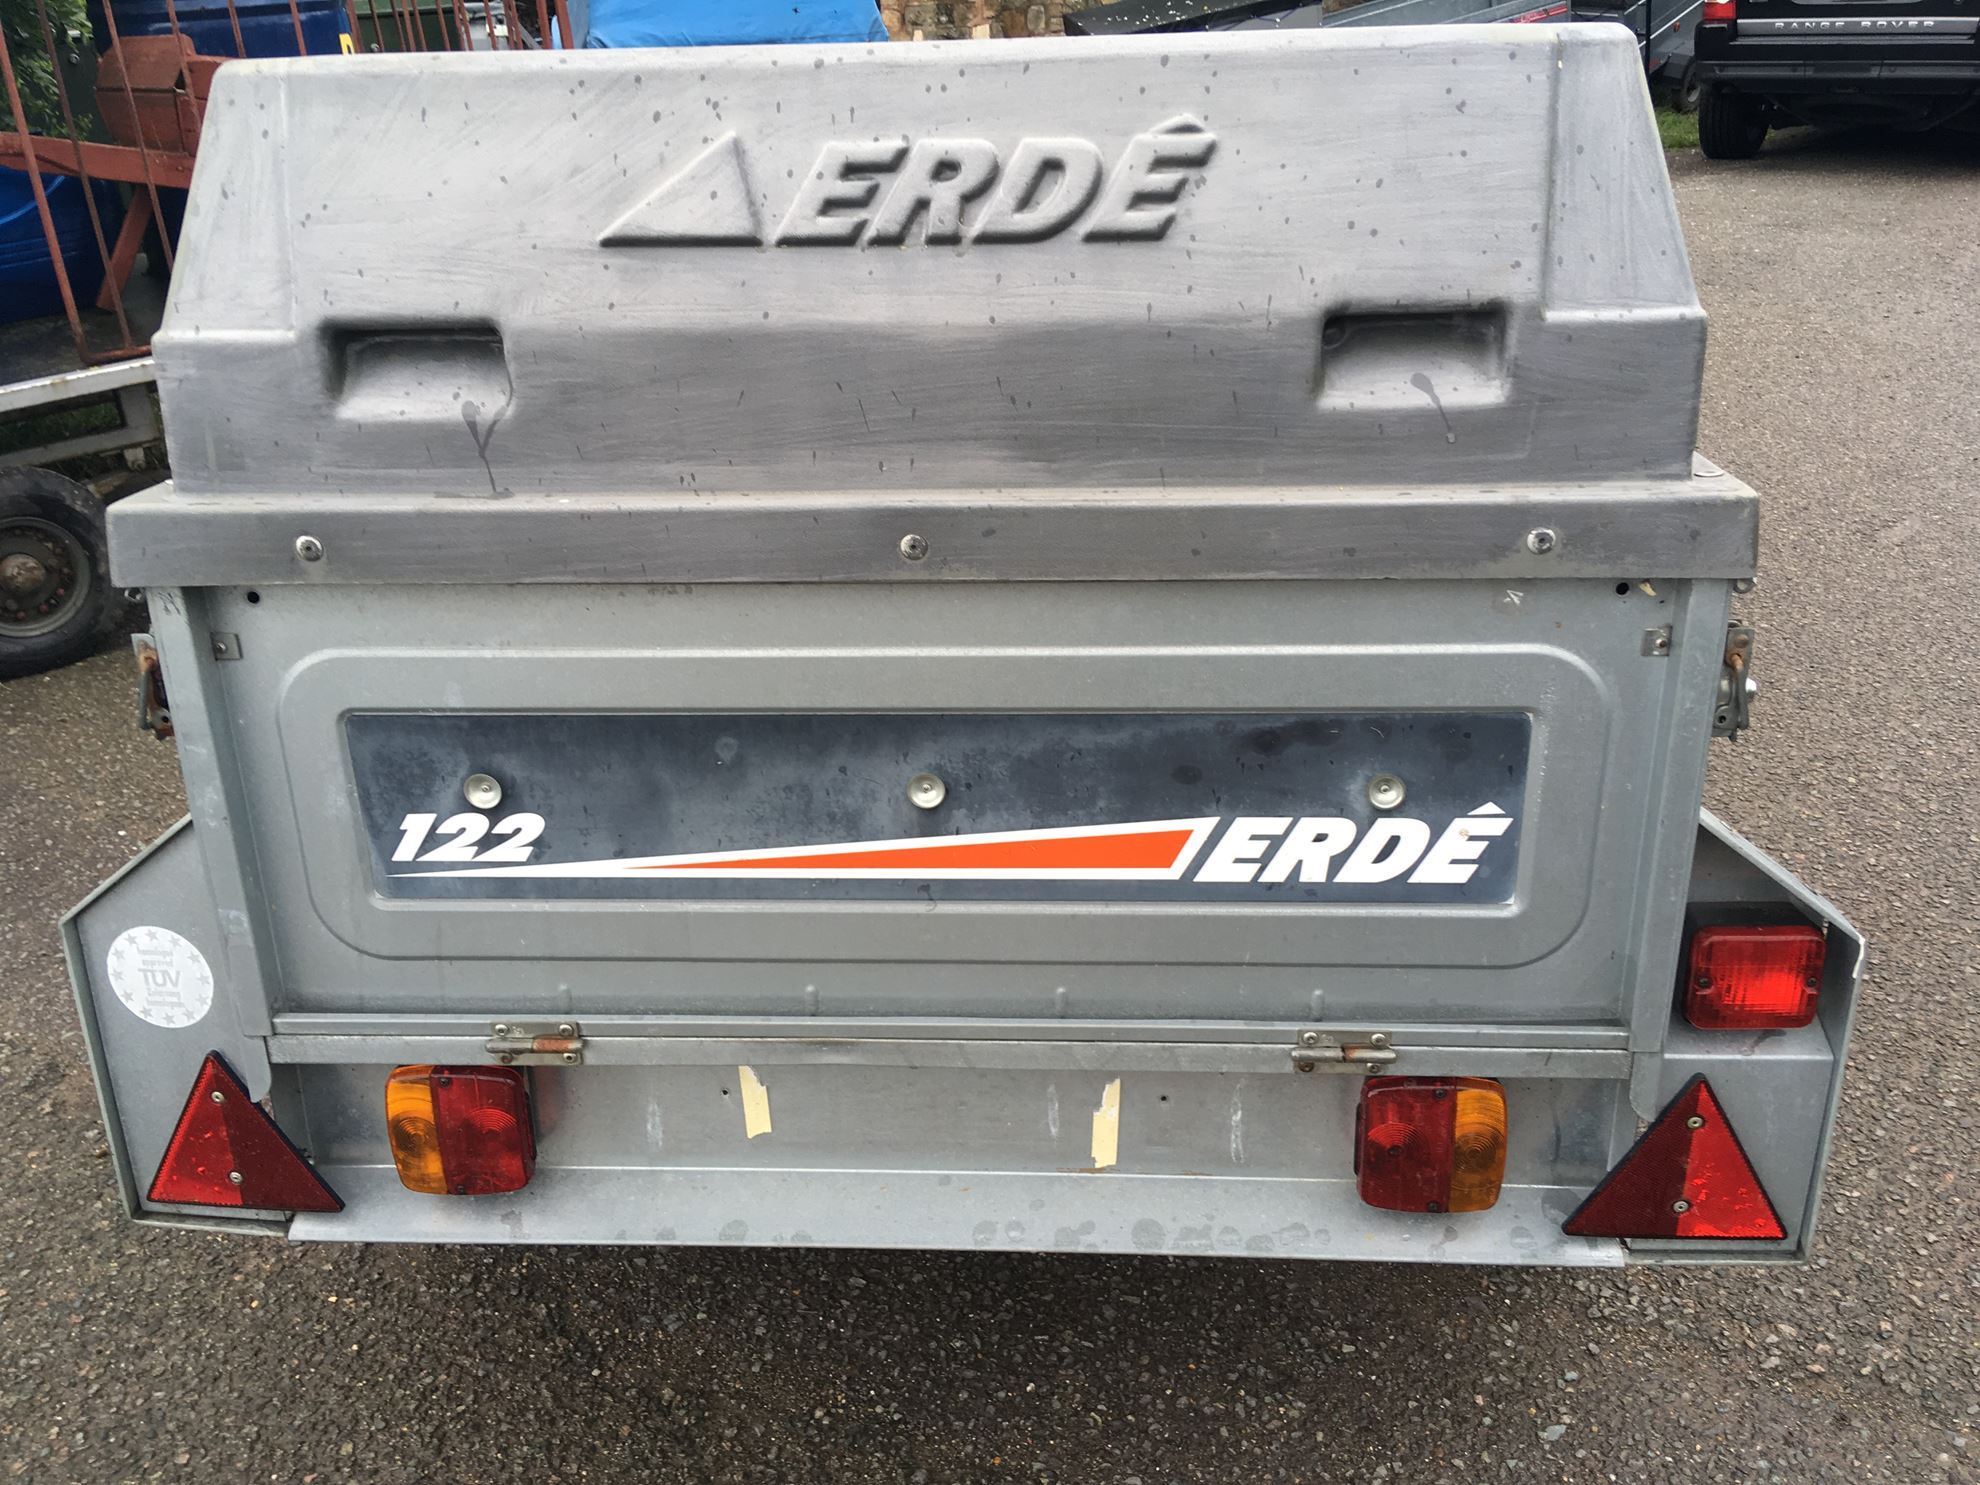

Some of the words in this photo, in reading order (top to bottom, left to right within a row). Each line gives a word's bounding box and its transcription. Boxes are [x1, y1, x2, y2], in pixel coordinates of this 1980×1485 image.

[1774, 21, 1846, 31] RANGE
[1860, 20, 1935, 30] ROVER
[391, 812, 546, 862] 122
